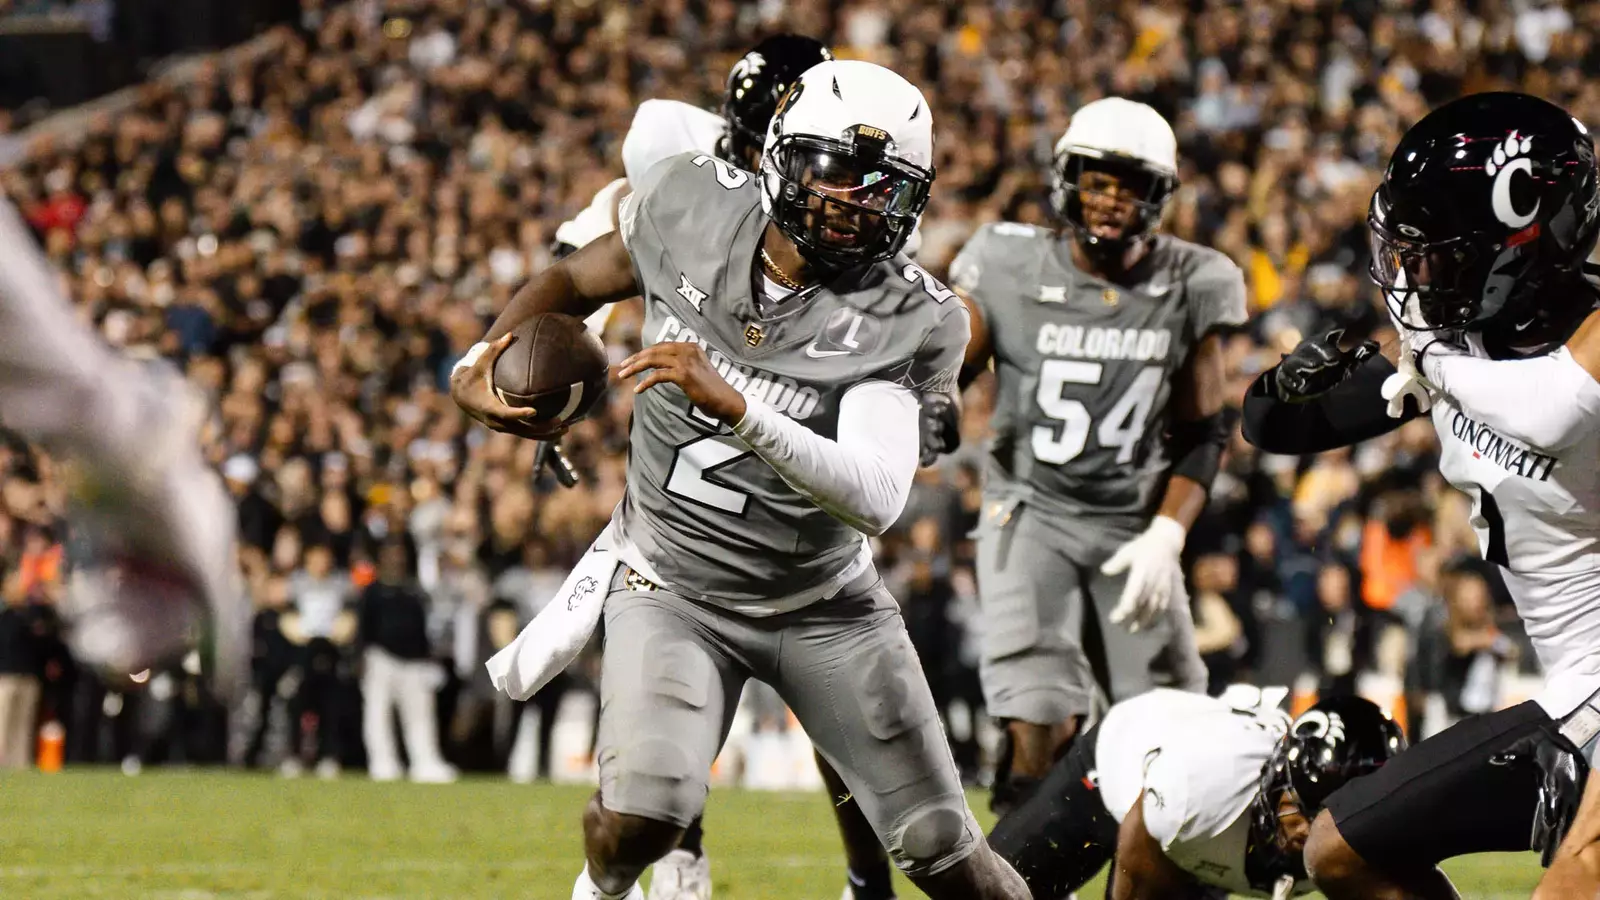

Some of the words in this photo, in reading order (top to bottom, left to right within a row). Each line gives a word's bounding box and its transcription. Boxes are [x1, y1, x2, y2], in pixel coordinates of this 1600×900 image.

[858, 125, 887, 140] BUFFS
[902, 263, 956, 304] 2
[842, 315, 864, 349] L
[1036, 323, 1171, 361] COLORADO
[1031, 359, 1164, 465] 54
[663, 402, 754, 518] 2
[1452, 412, 1559, 481] CINCINNATI
